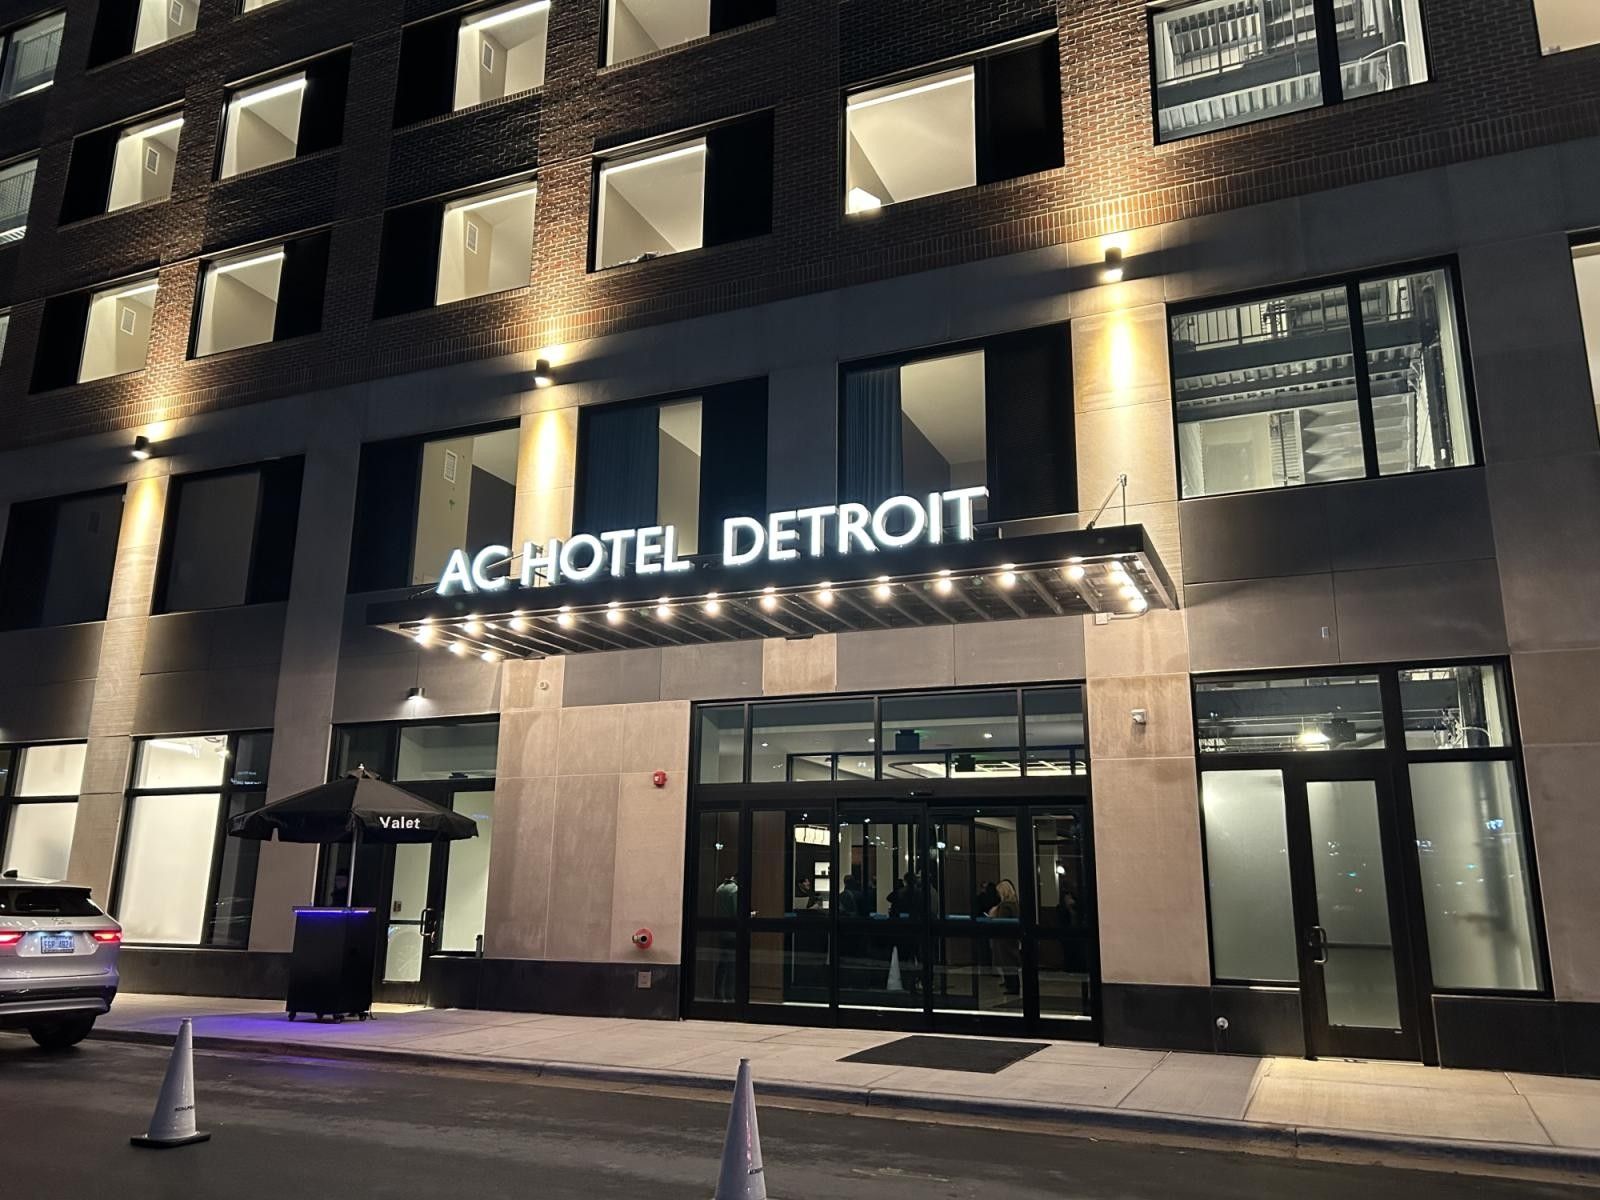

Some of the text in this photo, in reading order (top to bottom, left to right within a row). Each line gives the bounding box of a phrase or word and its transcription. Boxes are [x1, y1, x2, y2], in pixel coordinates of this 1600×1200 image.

[436, 485, 988, 596] AC HOTEL DETROIT
[379, 816, 421, 829] Valet
